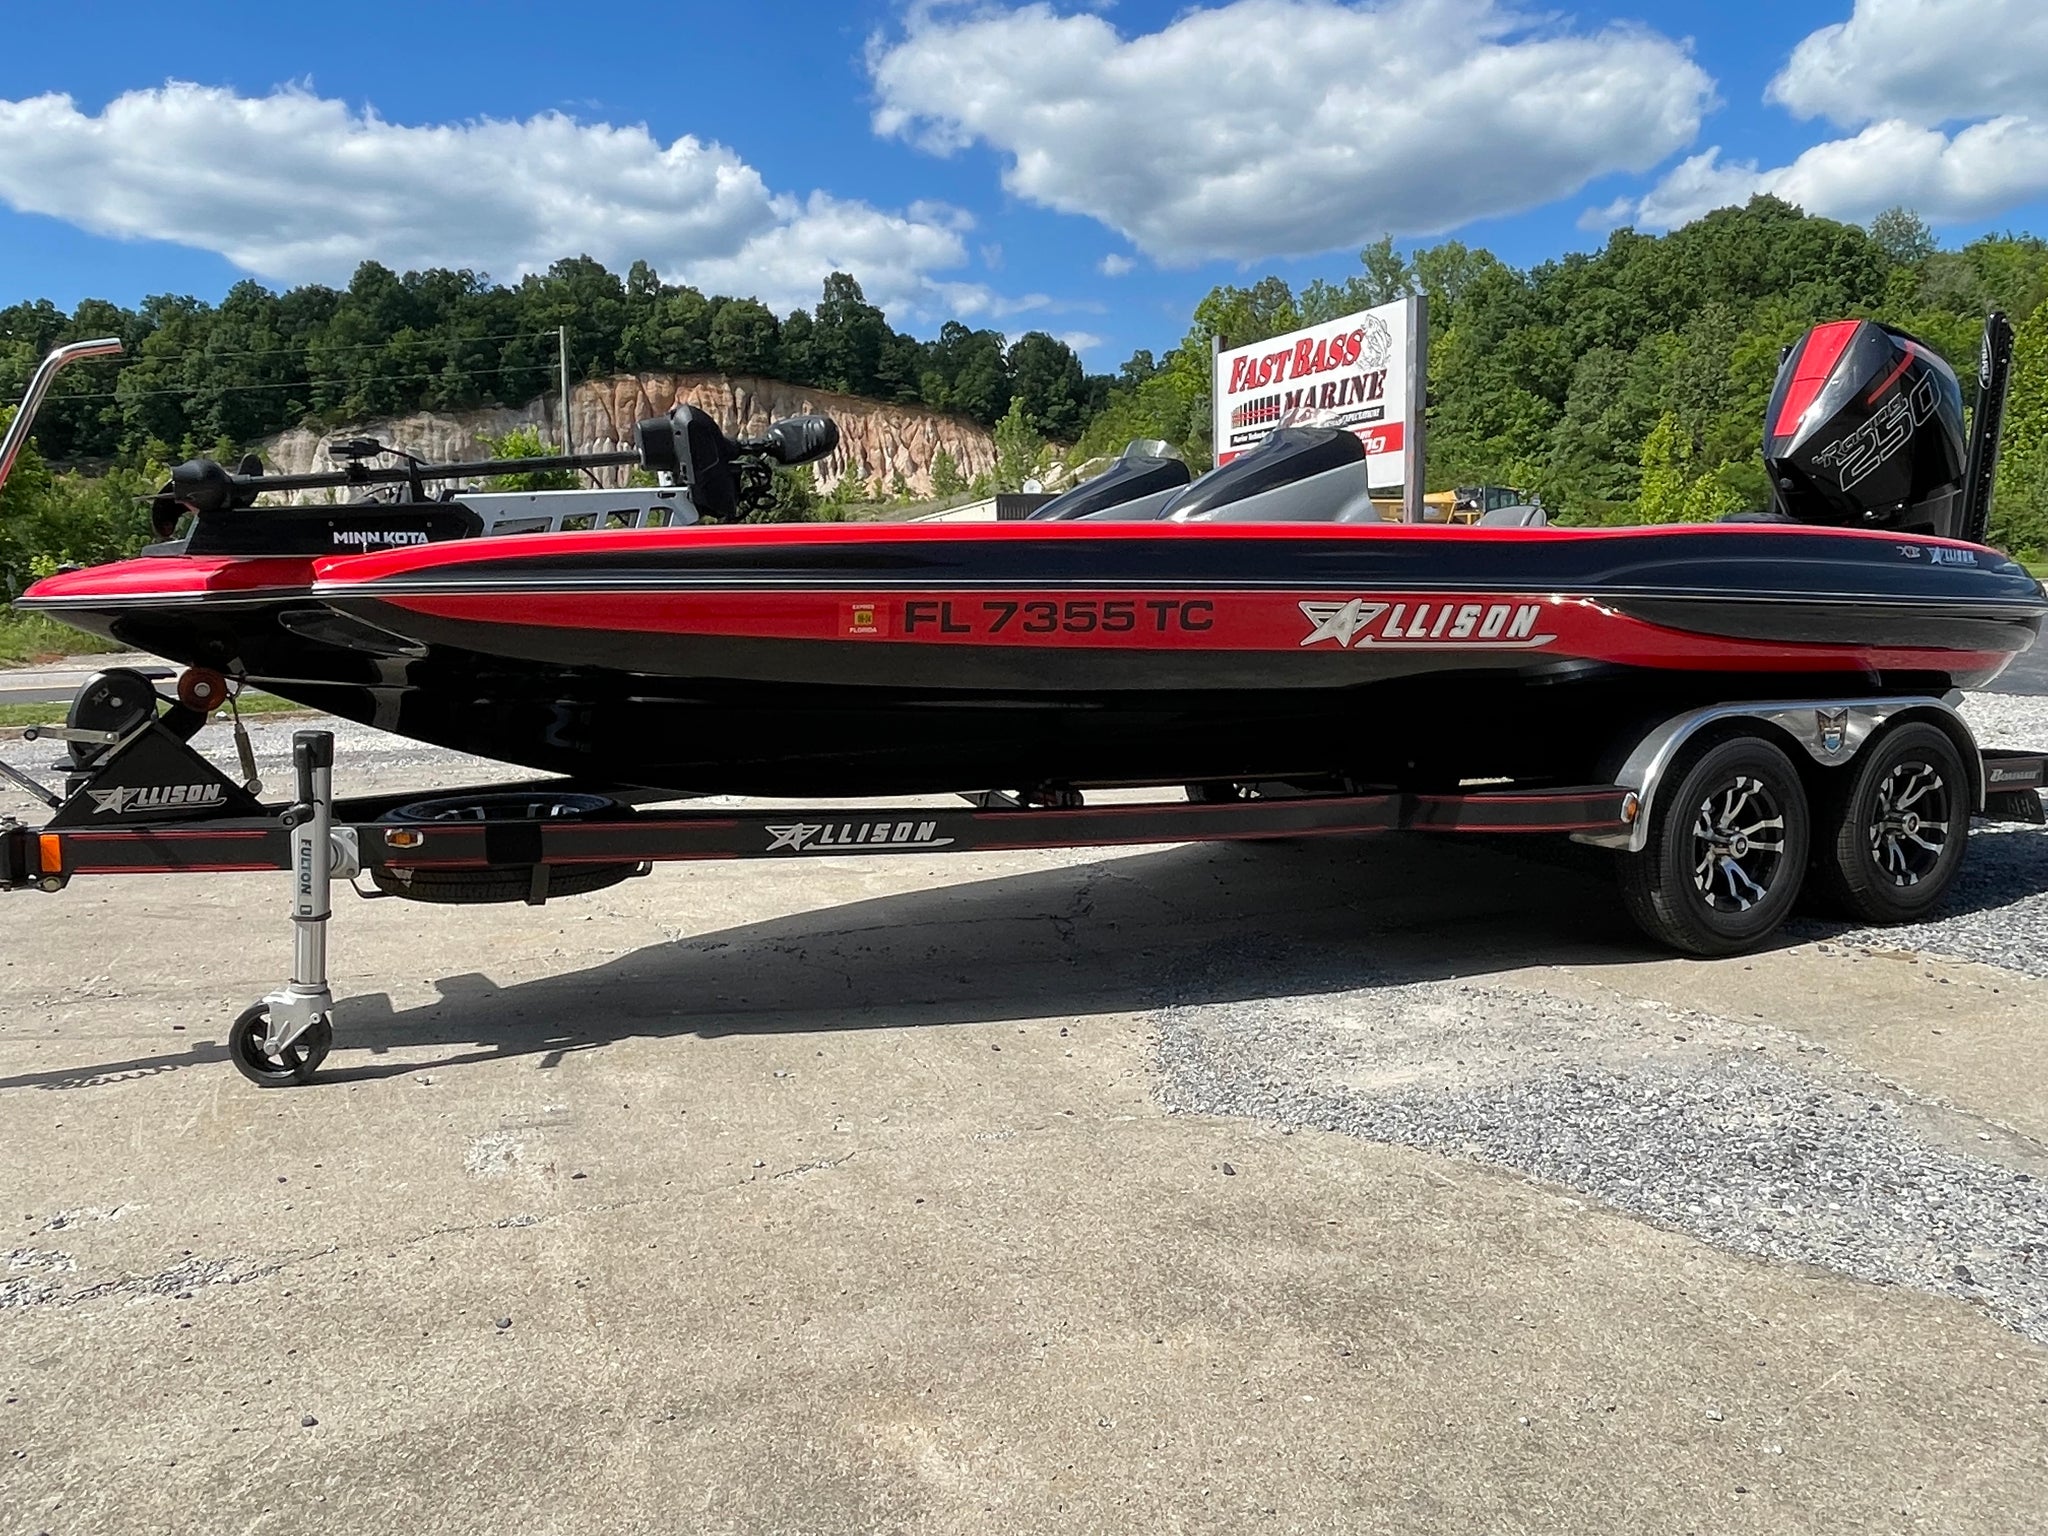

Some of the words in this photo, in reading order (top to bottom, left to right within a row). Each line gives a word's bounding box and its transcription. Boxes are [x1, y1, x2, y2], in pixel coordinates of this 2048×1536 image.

[1283, 369, 1387, 413] MARINE
[1837, 368, 1942, 492] 250
[333, 531, 380, 544] MINN
[383, 532, 429, 544] KOTA
[904, 601, 971, 633] FL
[983, 601, 1135, 633] 7355
[1146, 600, 1214, 631] TC
[1299, 598, 1558, 648] ALLISON
[86, 785, 227, 815] ALLISON
[765, 822, 955, 851] ALLISON
[300, 838, 312, 897] FULTON
